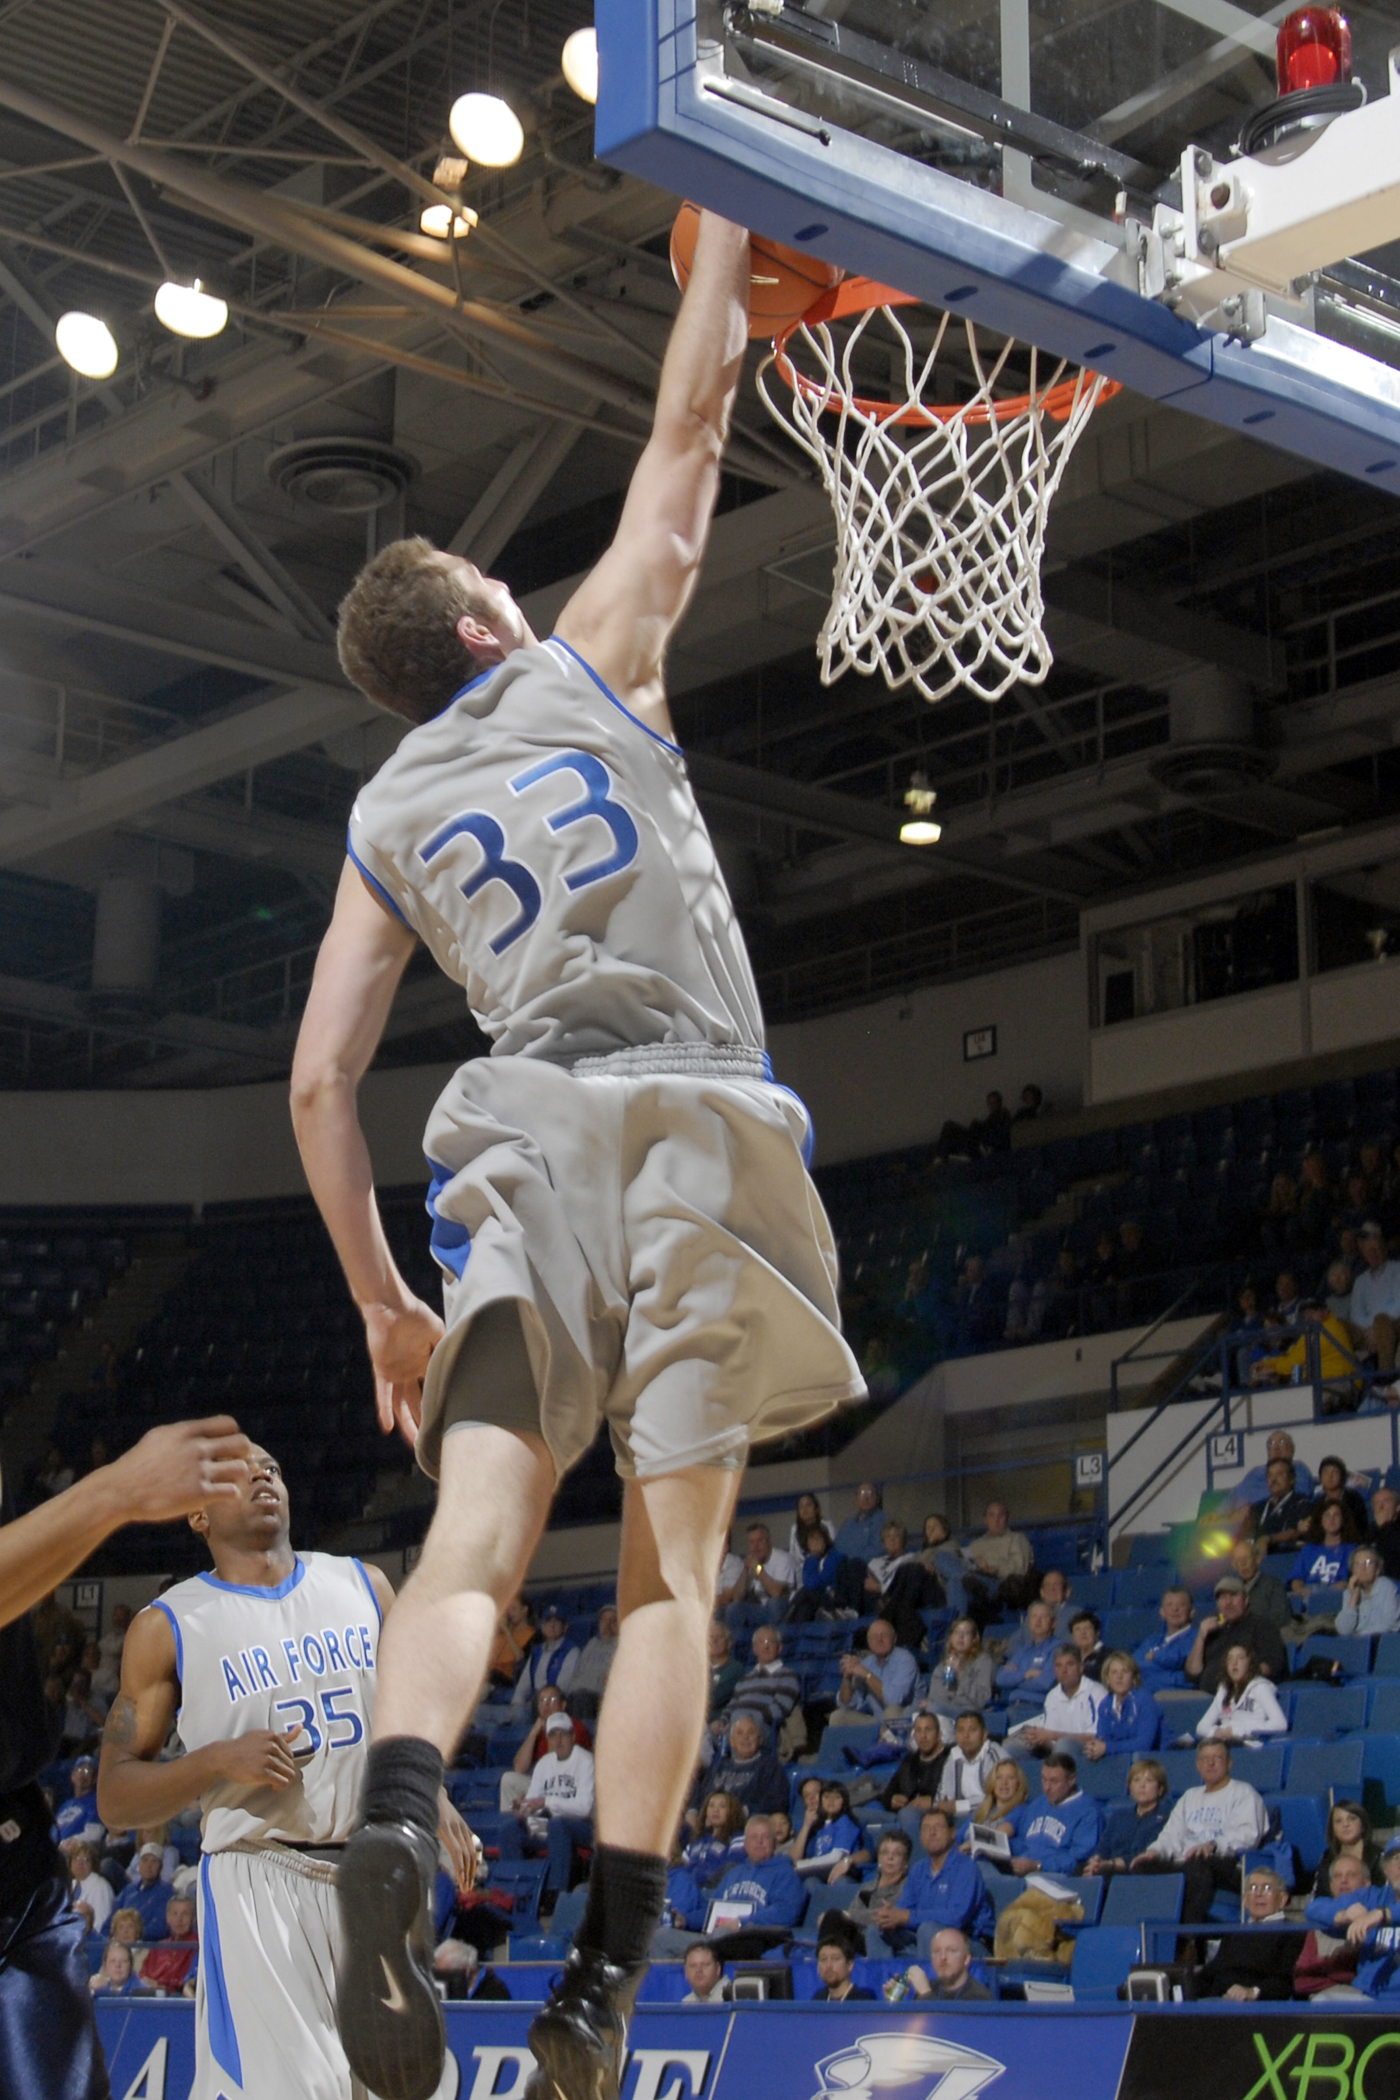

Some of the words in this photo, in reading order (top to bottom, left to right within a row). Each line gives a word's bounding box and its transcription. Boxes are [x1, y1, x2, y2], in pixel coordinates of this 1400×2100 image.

[415, 749, 638, 958] 33
[1213, 1437, 1236, 1457] L4
[1080, 1456, 1101, 1476] L3
[220, 1645, 282, 1704] AIR
[280, 1624, 376, 1684] FORCE
[274, 1685, 364, 1759] 35
[1026, 1816, 1044, 1838] AIR
[1043, 1815, 1066, 1845] FORCE
[738, 1880, 767, 1907] FORCE
